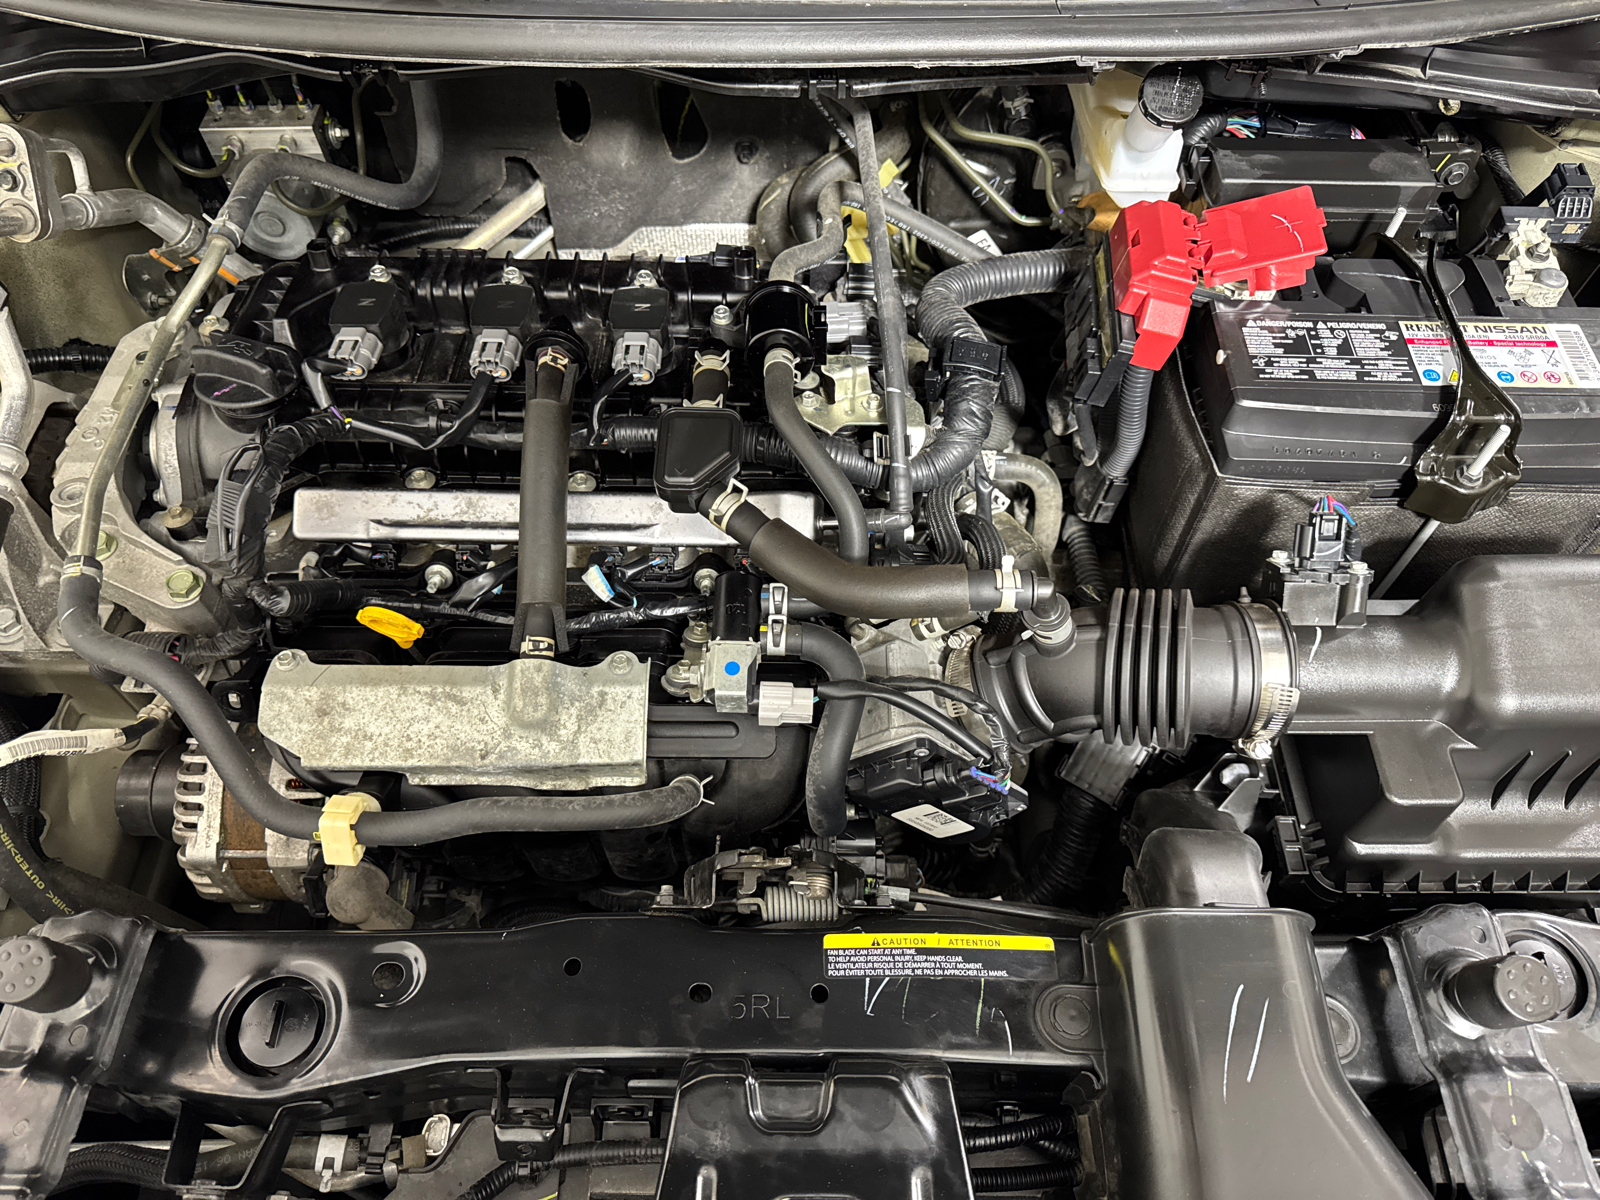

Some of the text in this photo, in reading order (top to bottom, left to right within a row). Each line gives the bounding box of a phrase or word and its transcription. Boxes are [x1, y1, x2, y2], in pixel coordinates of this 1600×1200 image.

[1404, 323, 1548, 335] RENAT NISSAN
[881, 938, 927, 946] CAUTION
[948, 938, 1001, 947] ATTENTION
[732, 993, 791, 1020] 5RL
